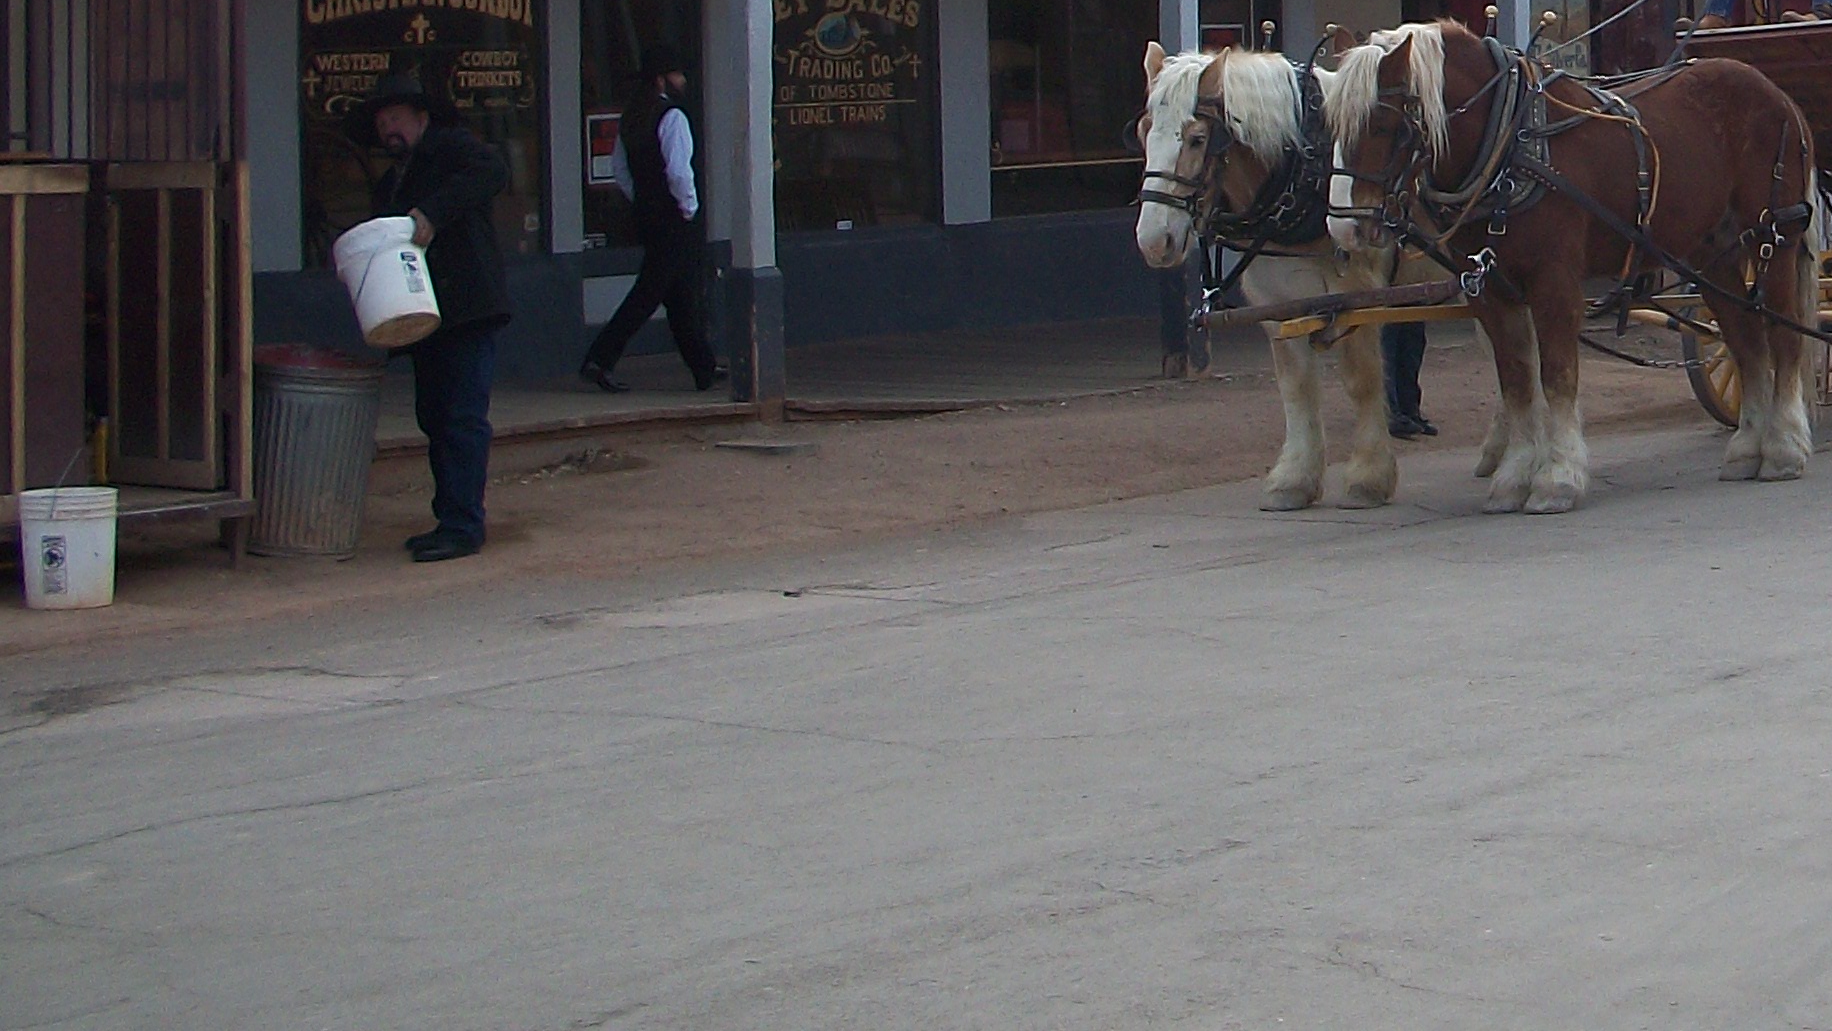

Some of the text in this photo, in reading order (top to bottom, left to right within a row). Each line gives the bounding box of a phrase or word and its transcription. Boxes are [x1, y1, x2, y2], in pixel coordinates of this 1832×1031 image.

[315, 53, 392, 70] WESTERN
[461, 50, 519, 67] COWBOY
[788, 49, 894, 79] TRADING CO.
[457, 70, 523, 88] TRINKETS
[780, 83, 895, 101] OF TOMBSTONE
[790, 104, 887, 126] LIONEL TRAINS
